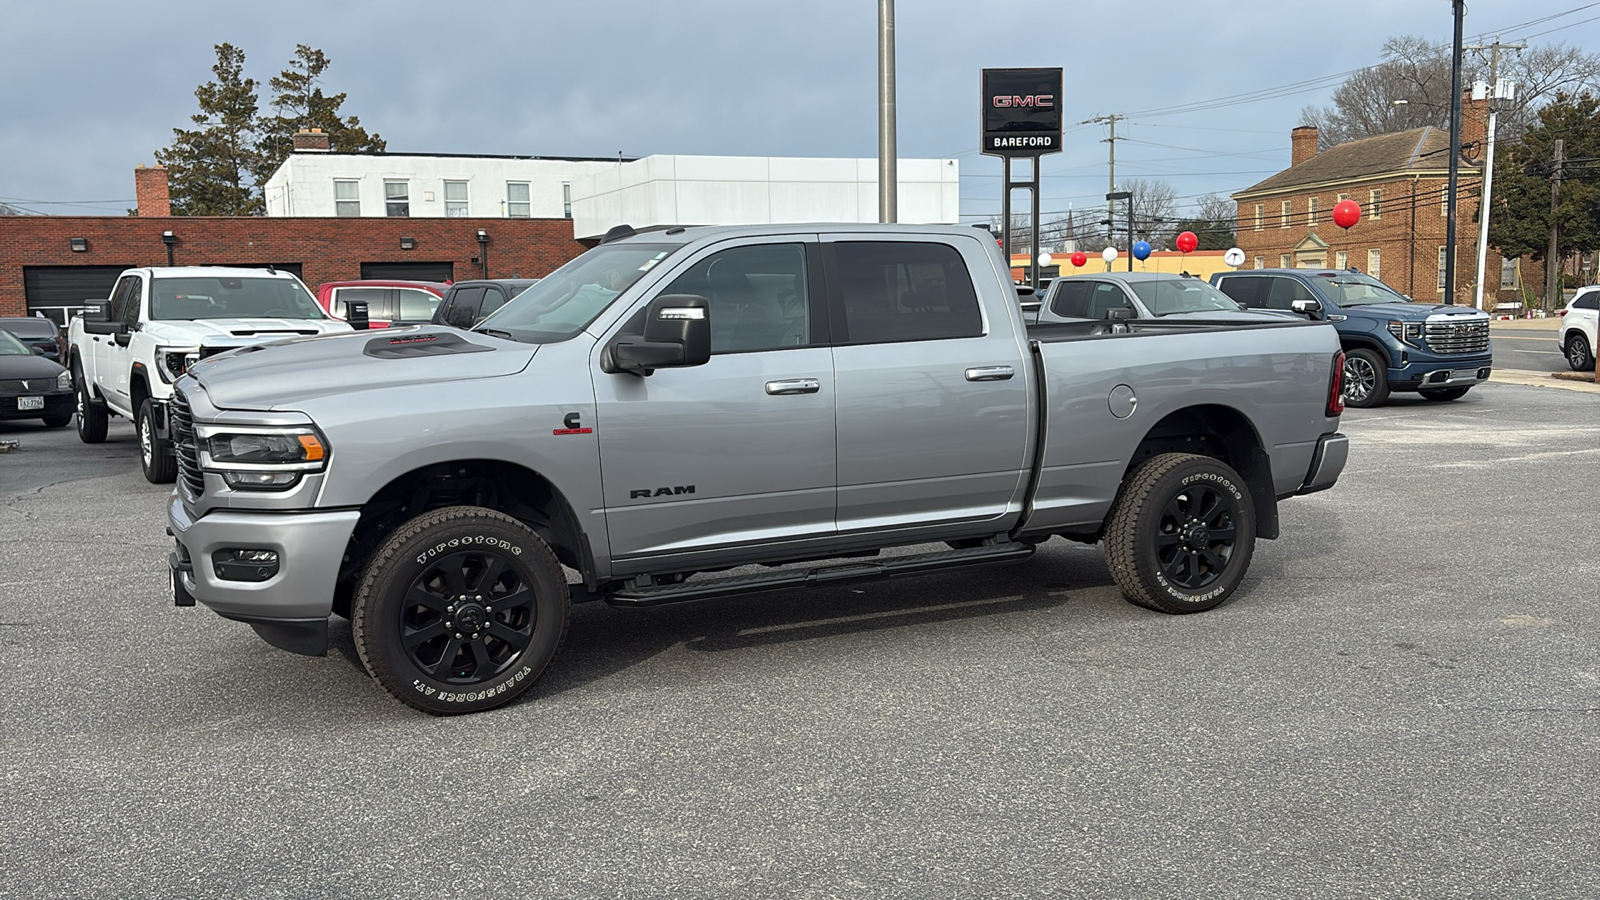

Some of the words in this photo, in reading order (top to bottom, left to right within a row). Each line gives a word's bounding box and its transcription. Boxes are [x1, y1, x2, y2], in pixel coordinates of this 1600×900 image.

[993, 95, 1053, 107] GMC
[994, 136, 1052, 147] BAREFORD
[630, 485, 696, 499] RAM
[437, 666, 532, 702] TRANSFORCE
